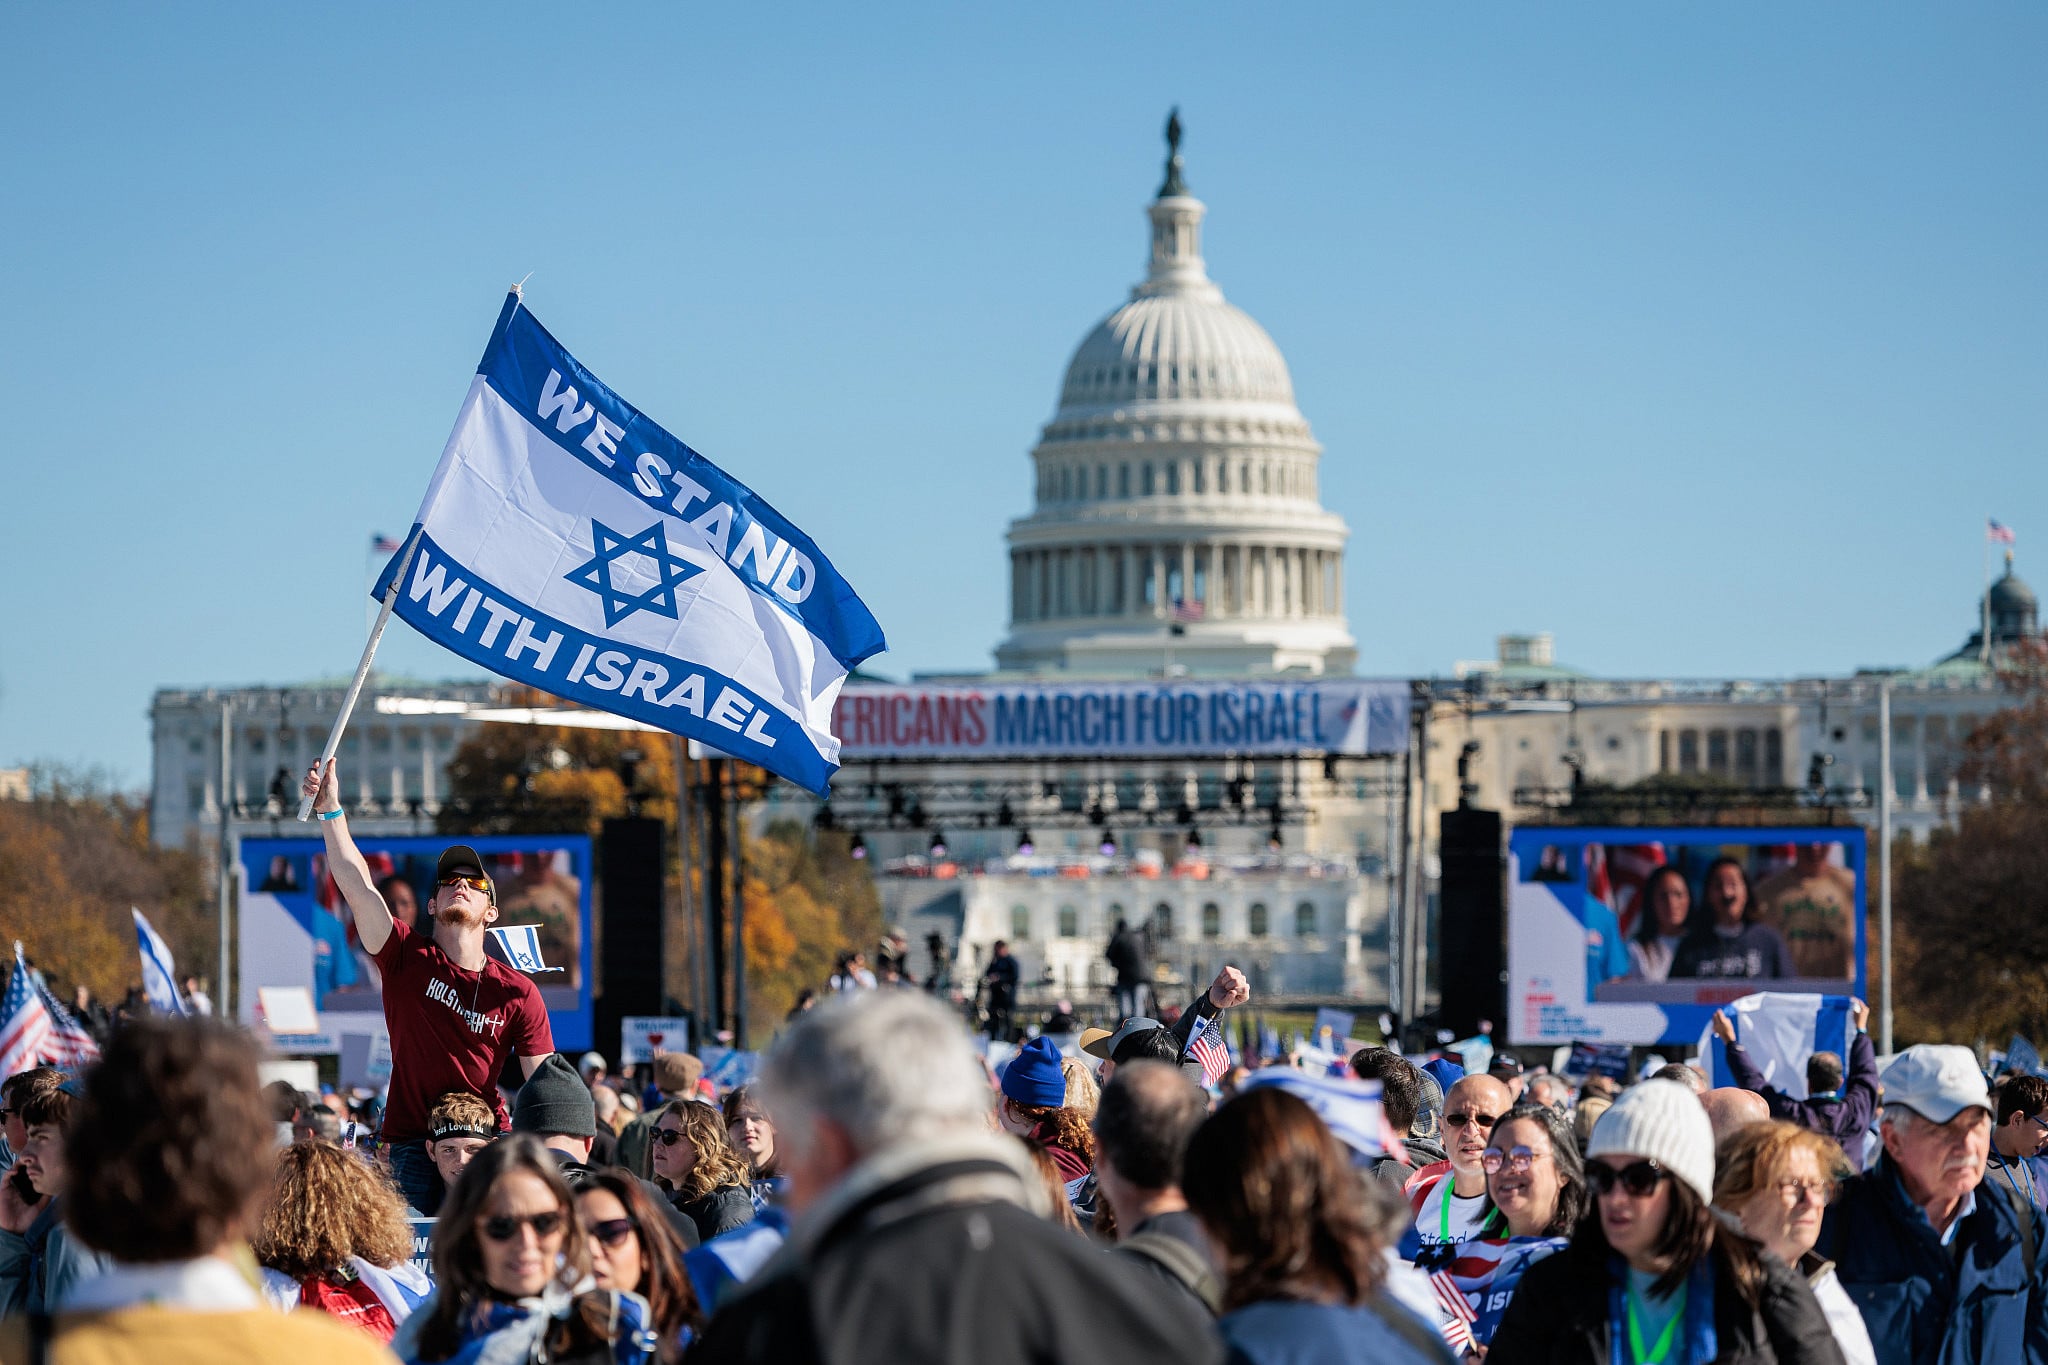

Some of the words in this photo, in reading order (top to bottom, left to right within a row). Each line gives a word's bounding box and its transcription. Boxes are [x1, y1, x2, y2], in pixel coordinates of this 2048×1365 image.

[536, 368, 626, 469] WE
[631, 451, 816, 604] STAND
[408, 548, 565, 673] WITH
[566, 643, 777, 748] ISRAEL
[831, 692, 987, 746] ERICANS
[994, 692, 1125, 746] MARCH
[1134, 690, 1200, 745] FOR
[1209, 689, 1329, 744] ISRAEL
[474, 1122, 484, 1134] You
